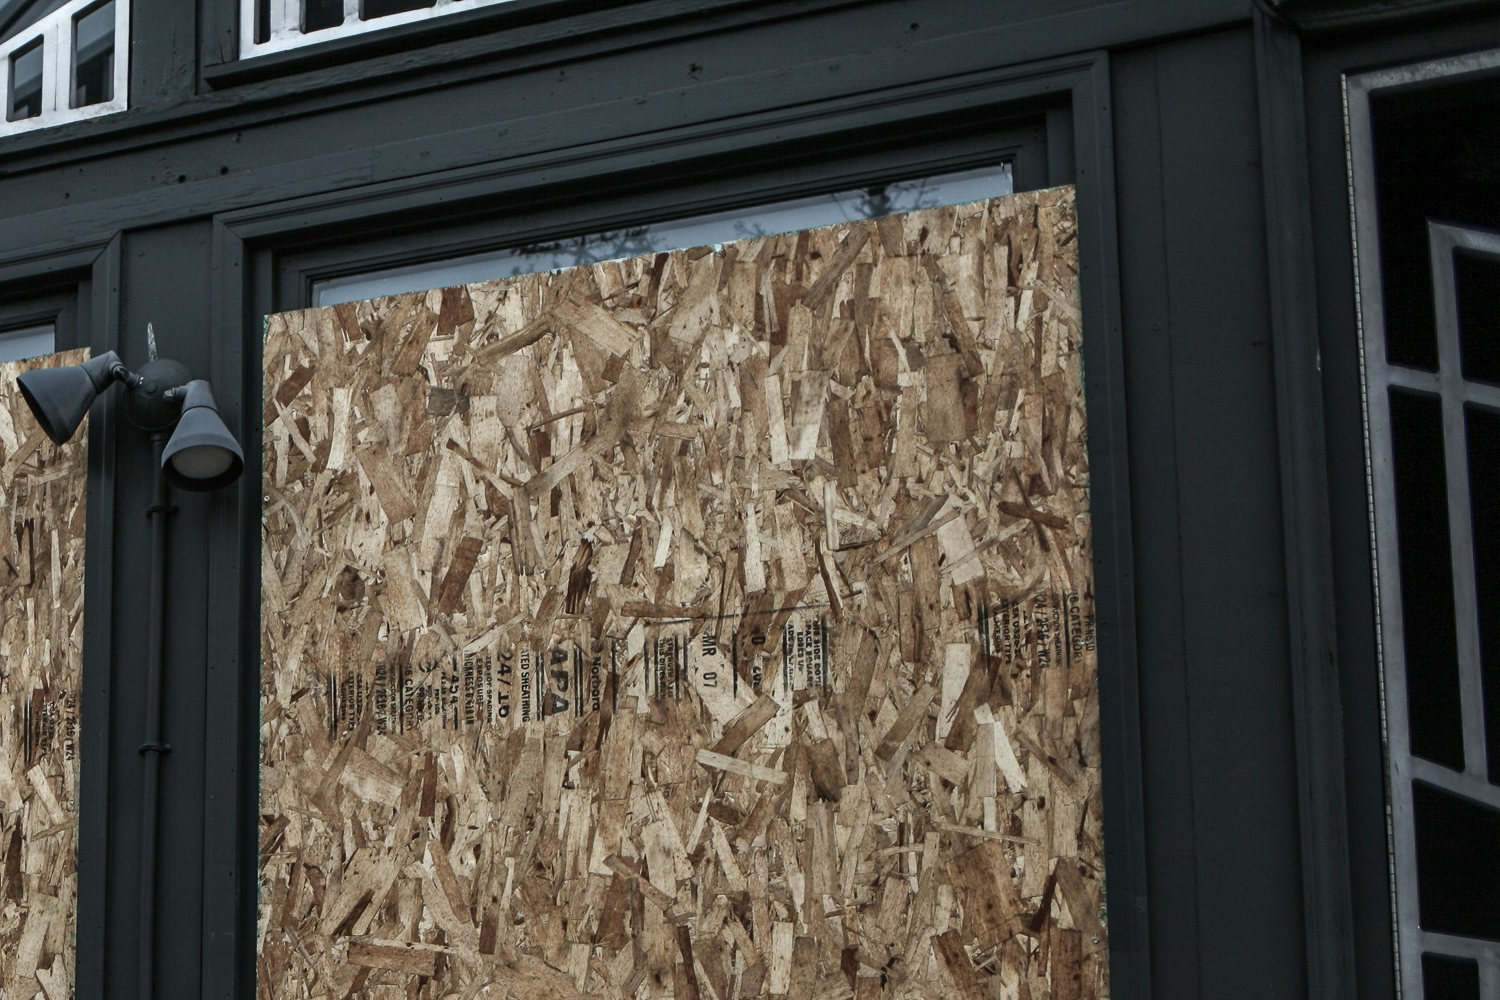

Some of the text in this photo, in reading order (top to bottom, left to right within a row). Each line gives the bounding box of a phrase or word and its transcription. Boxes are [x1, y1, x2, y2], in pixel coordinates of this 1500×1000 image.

[1085, 615, 1095, 651] PR-N610
[702, 635, 716, 687] MR 07
[1038, 649, 1050, 668] W24
[450, 675, 459, 703] 454
[522, 672, 530, 722] SHEATHING
[551, 647, 568, 715] APA
[592, 657, 601, 711] Norbord
[66, 717, 76, 736] 2F16
[66, 744, 76, 761] W24
